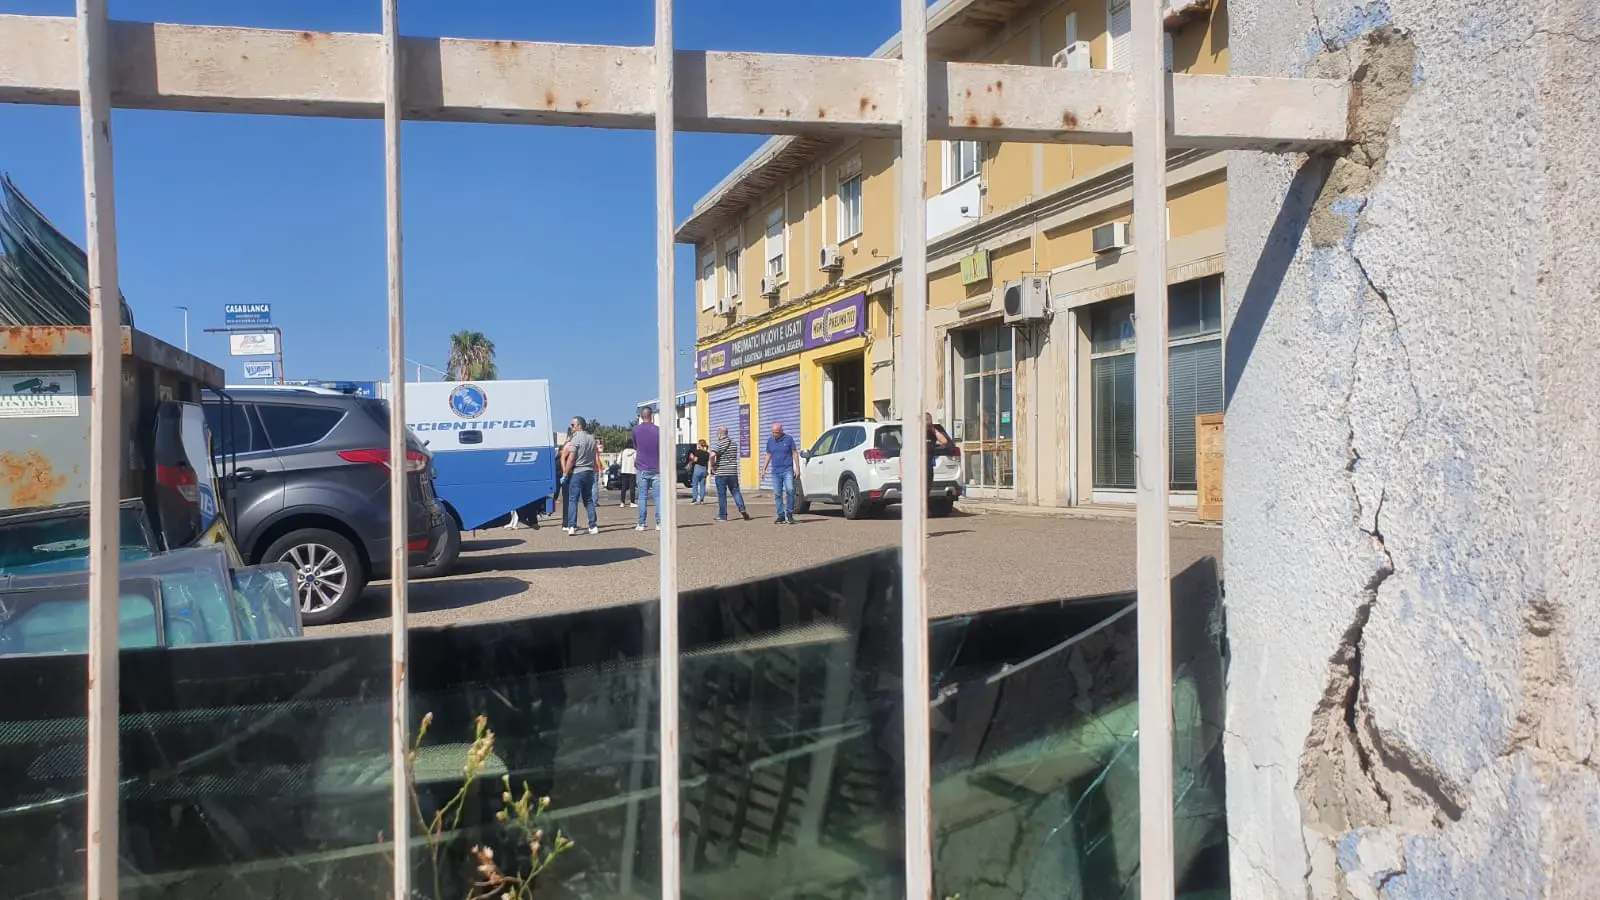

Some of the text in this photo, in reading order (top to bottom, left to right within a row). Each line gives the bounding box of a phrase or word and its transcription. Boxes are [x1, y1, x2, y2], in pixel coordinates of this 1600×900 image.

[225, 304, 270, 313] CASABLANCA
[731, 319, 802, 355] PNEUMATICI NUOVI E USATI
[764, 343, 786, 358] MECCANICA
[786, 339, 803, 352] LEGGERA
[506, 451, 539, 463] 113
